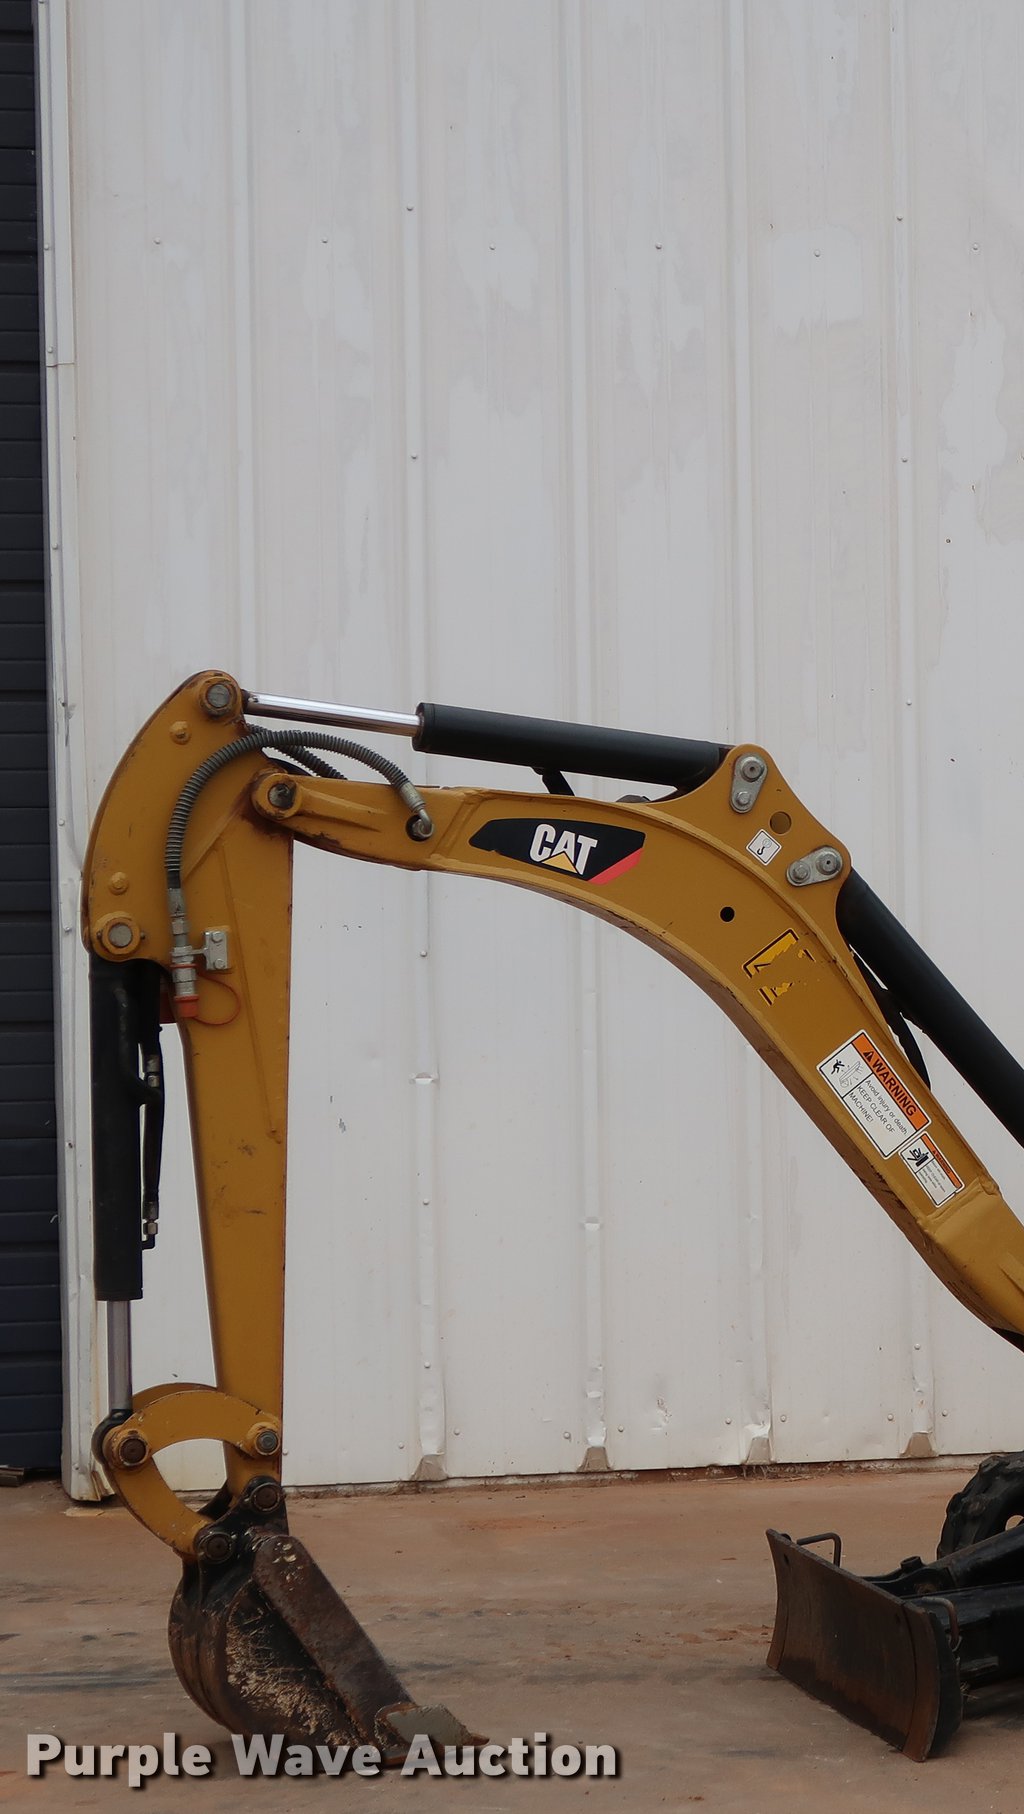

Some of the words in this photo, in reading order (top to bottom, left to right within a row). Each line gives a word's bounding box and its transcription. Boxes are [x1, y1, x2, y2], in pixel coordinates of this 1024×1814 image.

[529, 823, 598, 875] CAT
[848, 1092, 874, 1124] MACHINE!
[856, 1085, 873, 1104] KEEP
[869, 1102, 888, 1124] CLEAR
[885, 1123, 895, 1134] OF
[865, 1079, 880, 1097] Avoid
[875, 1095, 892, 1113] injury
[888, 1111, 897, 1120] or
[872, 1060, 917, 1117] WARNING
